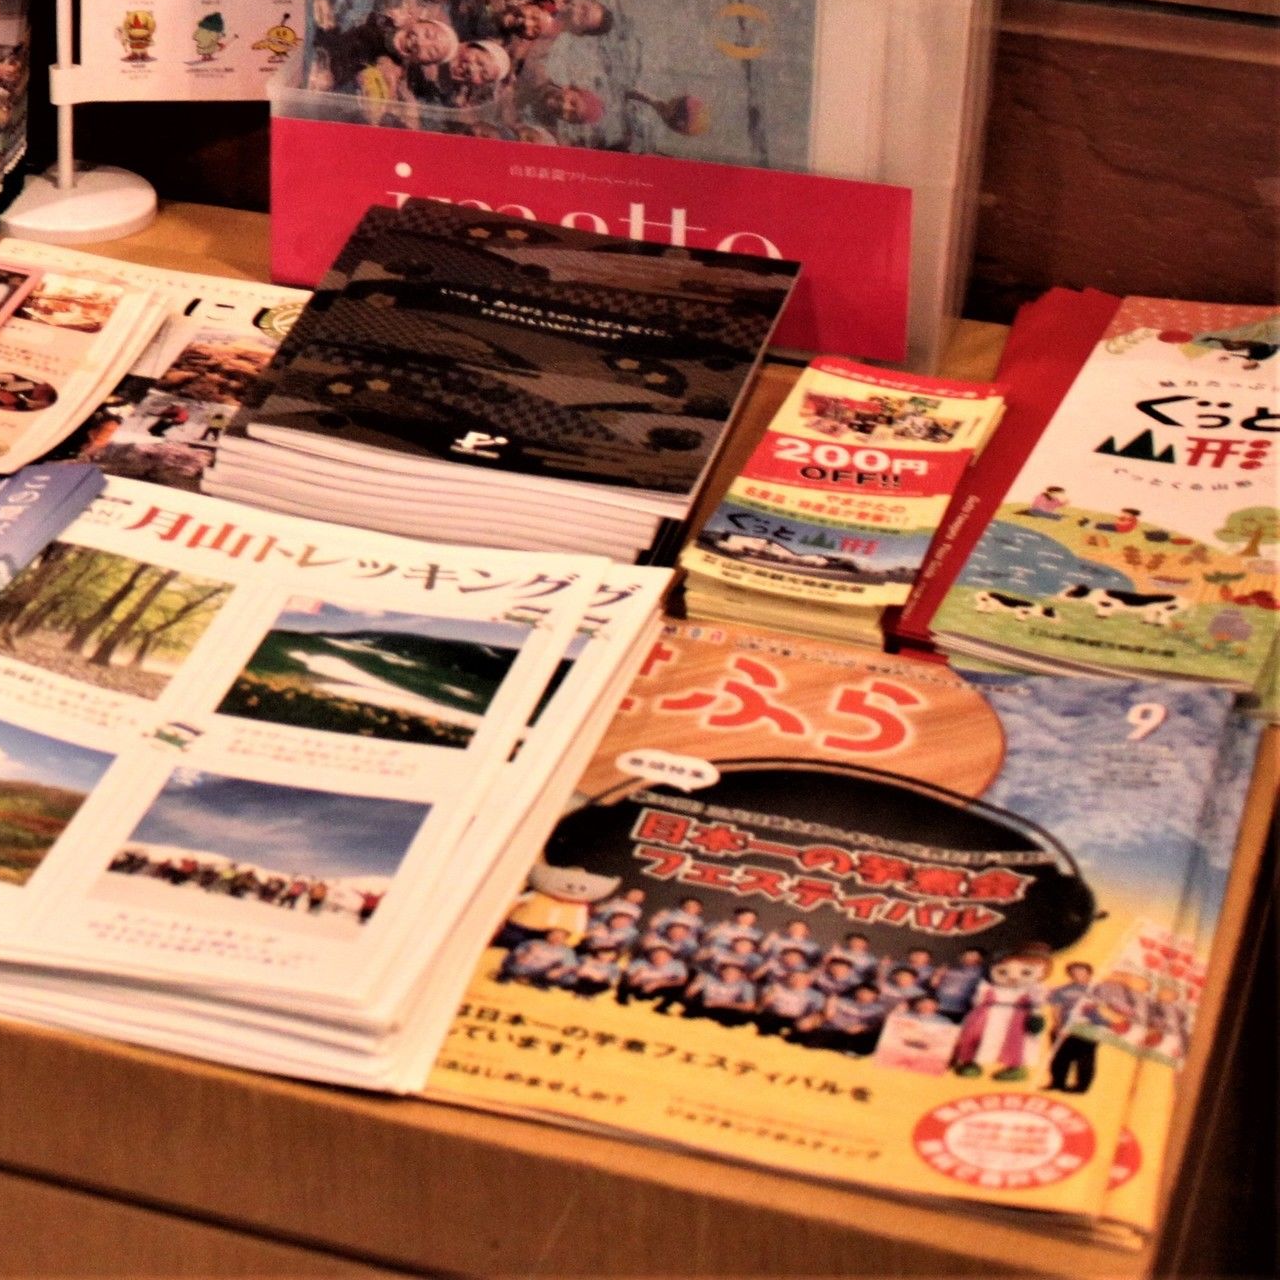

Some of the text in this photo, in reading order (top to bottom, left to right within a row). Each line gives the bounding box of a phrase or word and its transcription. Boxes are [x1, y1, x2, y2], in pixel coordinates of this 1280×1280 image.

[773, 436, 930, 477] 200円
[799, 465, 901, 488] OFF!!
[121, 502, 577, 609] 月山トレッキング
[1126, 701, 1167, 742] 9
[633, 844, 1009, 937] フェスティバル
